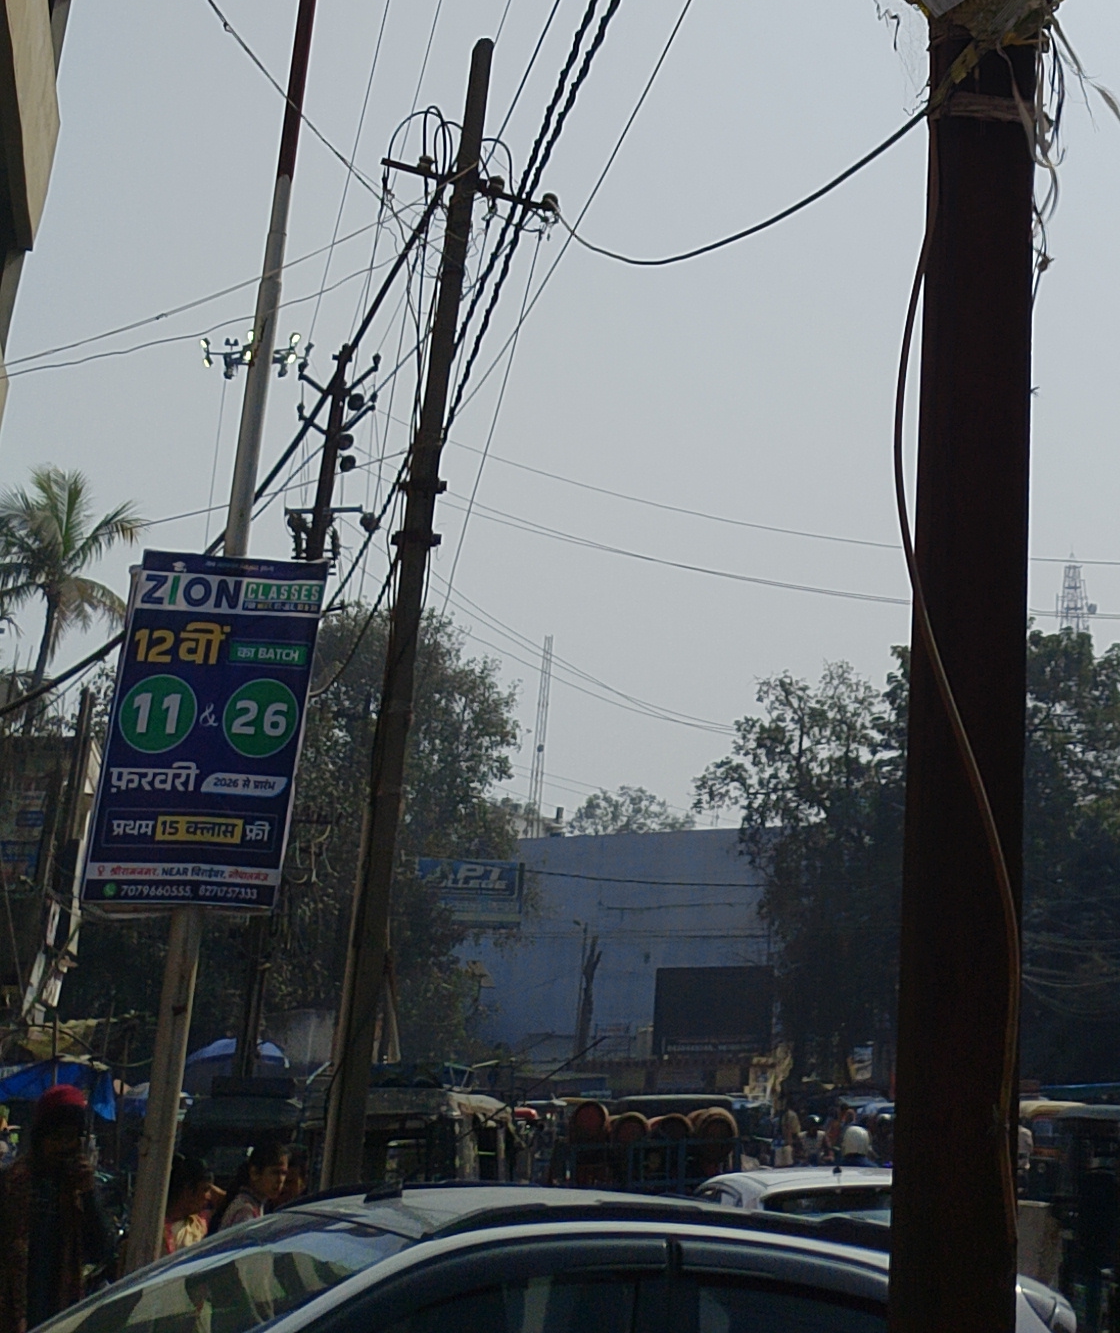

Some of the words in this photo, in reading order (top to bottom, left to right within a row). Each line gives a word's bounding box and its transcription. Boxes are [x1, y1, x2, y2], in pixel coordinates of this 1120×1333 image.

[141, 574, 243, 609] ZION
[245, 582, 321, 601] CLASSES
[134, 621, 231, 665] 12वीं
[237, 646, 256, 658] का
[258, 647, 299, 662] BATCH
[133, 693, 182, 735] 11
[200, 702, 219, 727] &
[231, 699, 288, 737] 26
[110, 761, 200, 793] फ़रवरी
[213, 777, 239, 788] 2026
[242, 777, 251, 789] से
[252, 778, 277, 791] प्रारंभ
[112, 819, 155, 836] प्रथम
[161, 820, 179, 836] 15
[185, 821, 238, 839] क्लास
[245, 820, 271, 842] फ्री
[161, 867, 189, 877] NEAR
